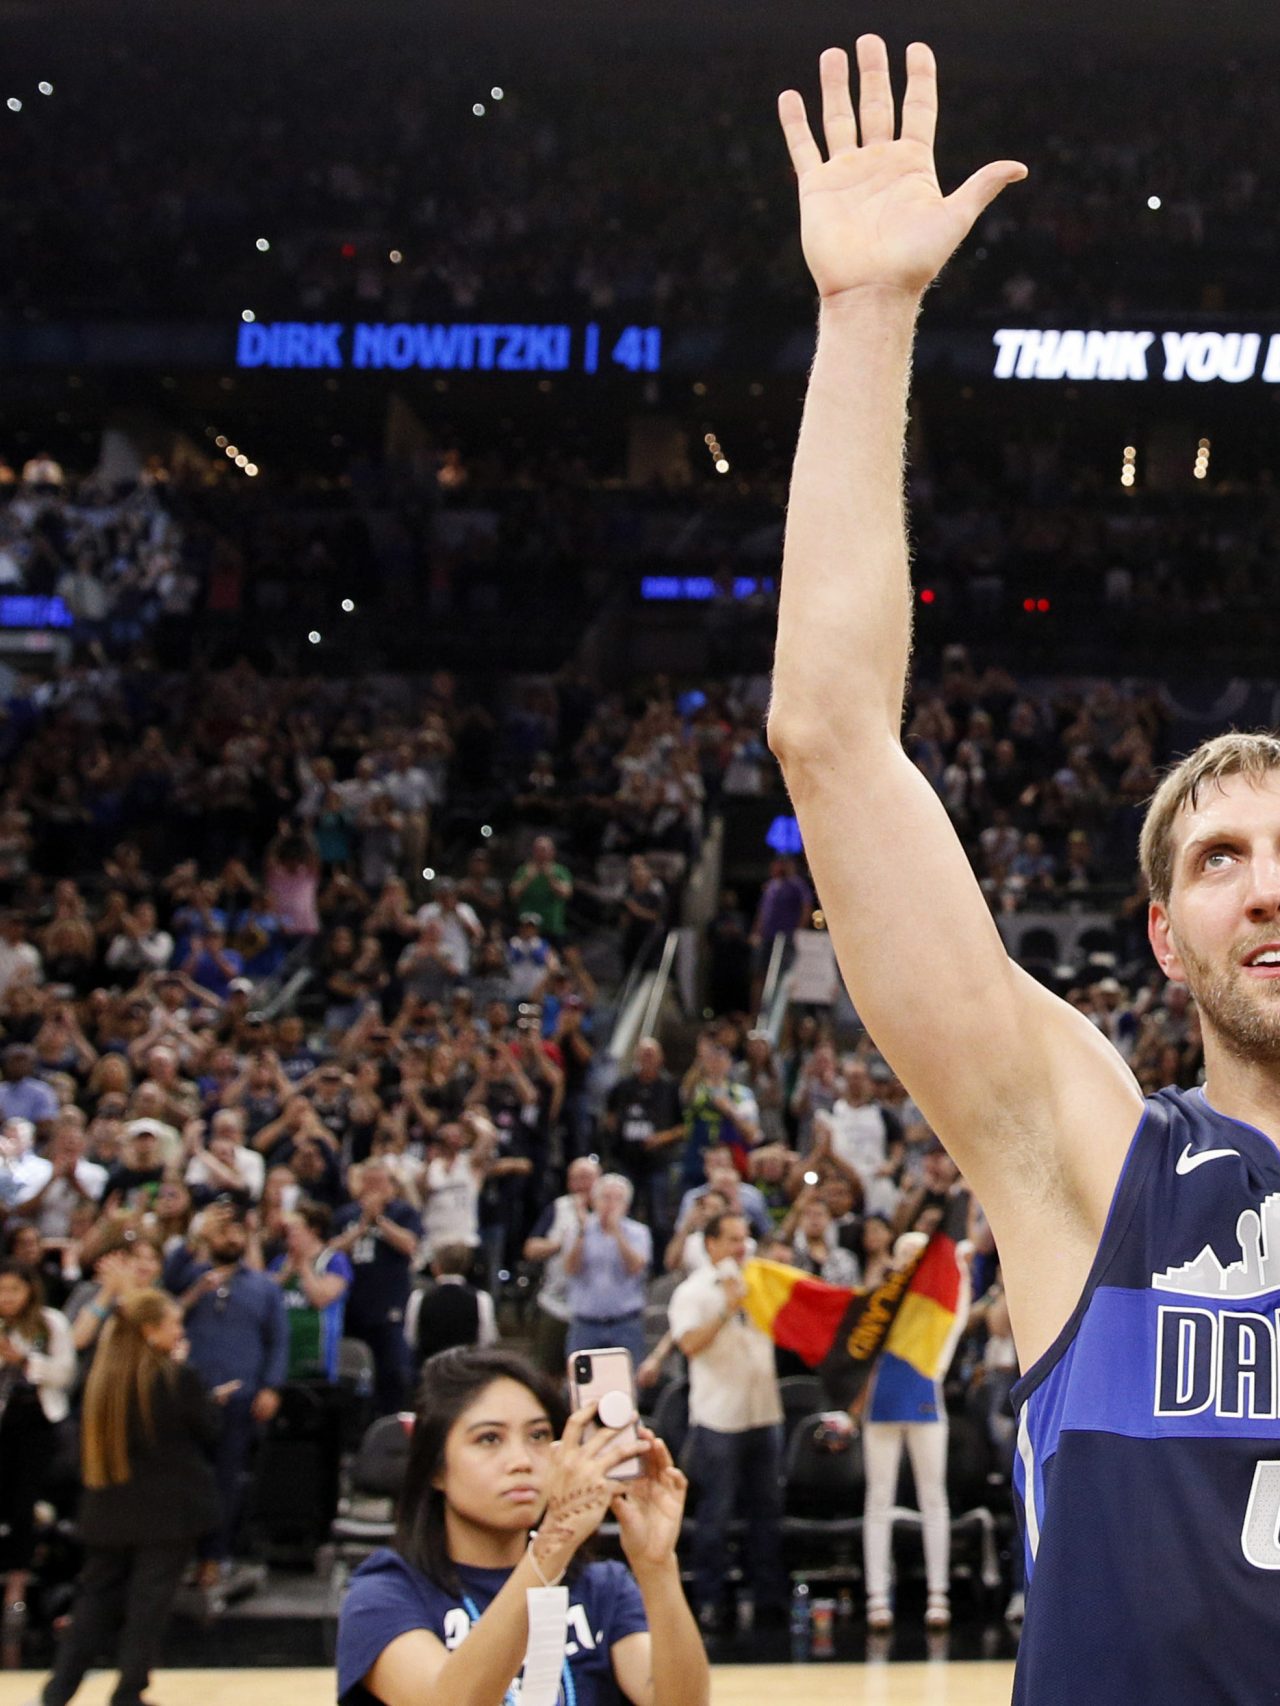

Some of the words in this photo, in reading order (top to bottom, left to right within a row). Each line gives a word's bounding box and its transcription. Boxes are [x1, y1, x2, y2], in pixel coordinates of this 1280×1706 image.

[236, 322, 344, 369] DIRK
[352, 323, 571, 372] NOWITZKI
[612, 326, 662, 372] 41
[993, 328, 1155, 381] THANK
[1161, 331, 1261, 383] YOU
